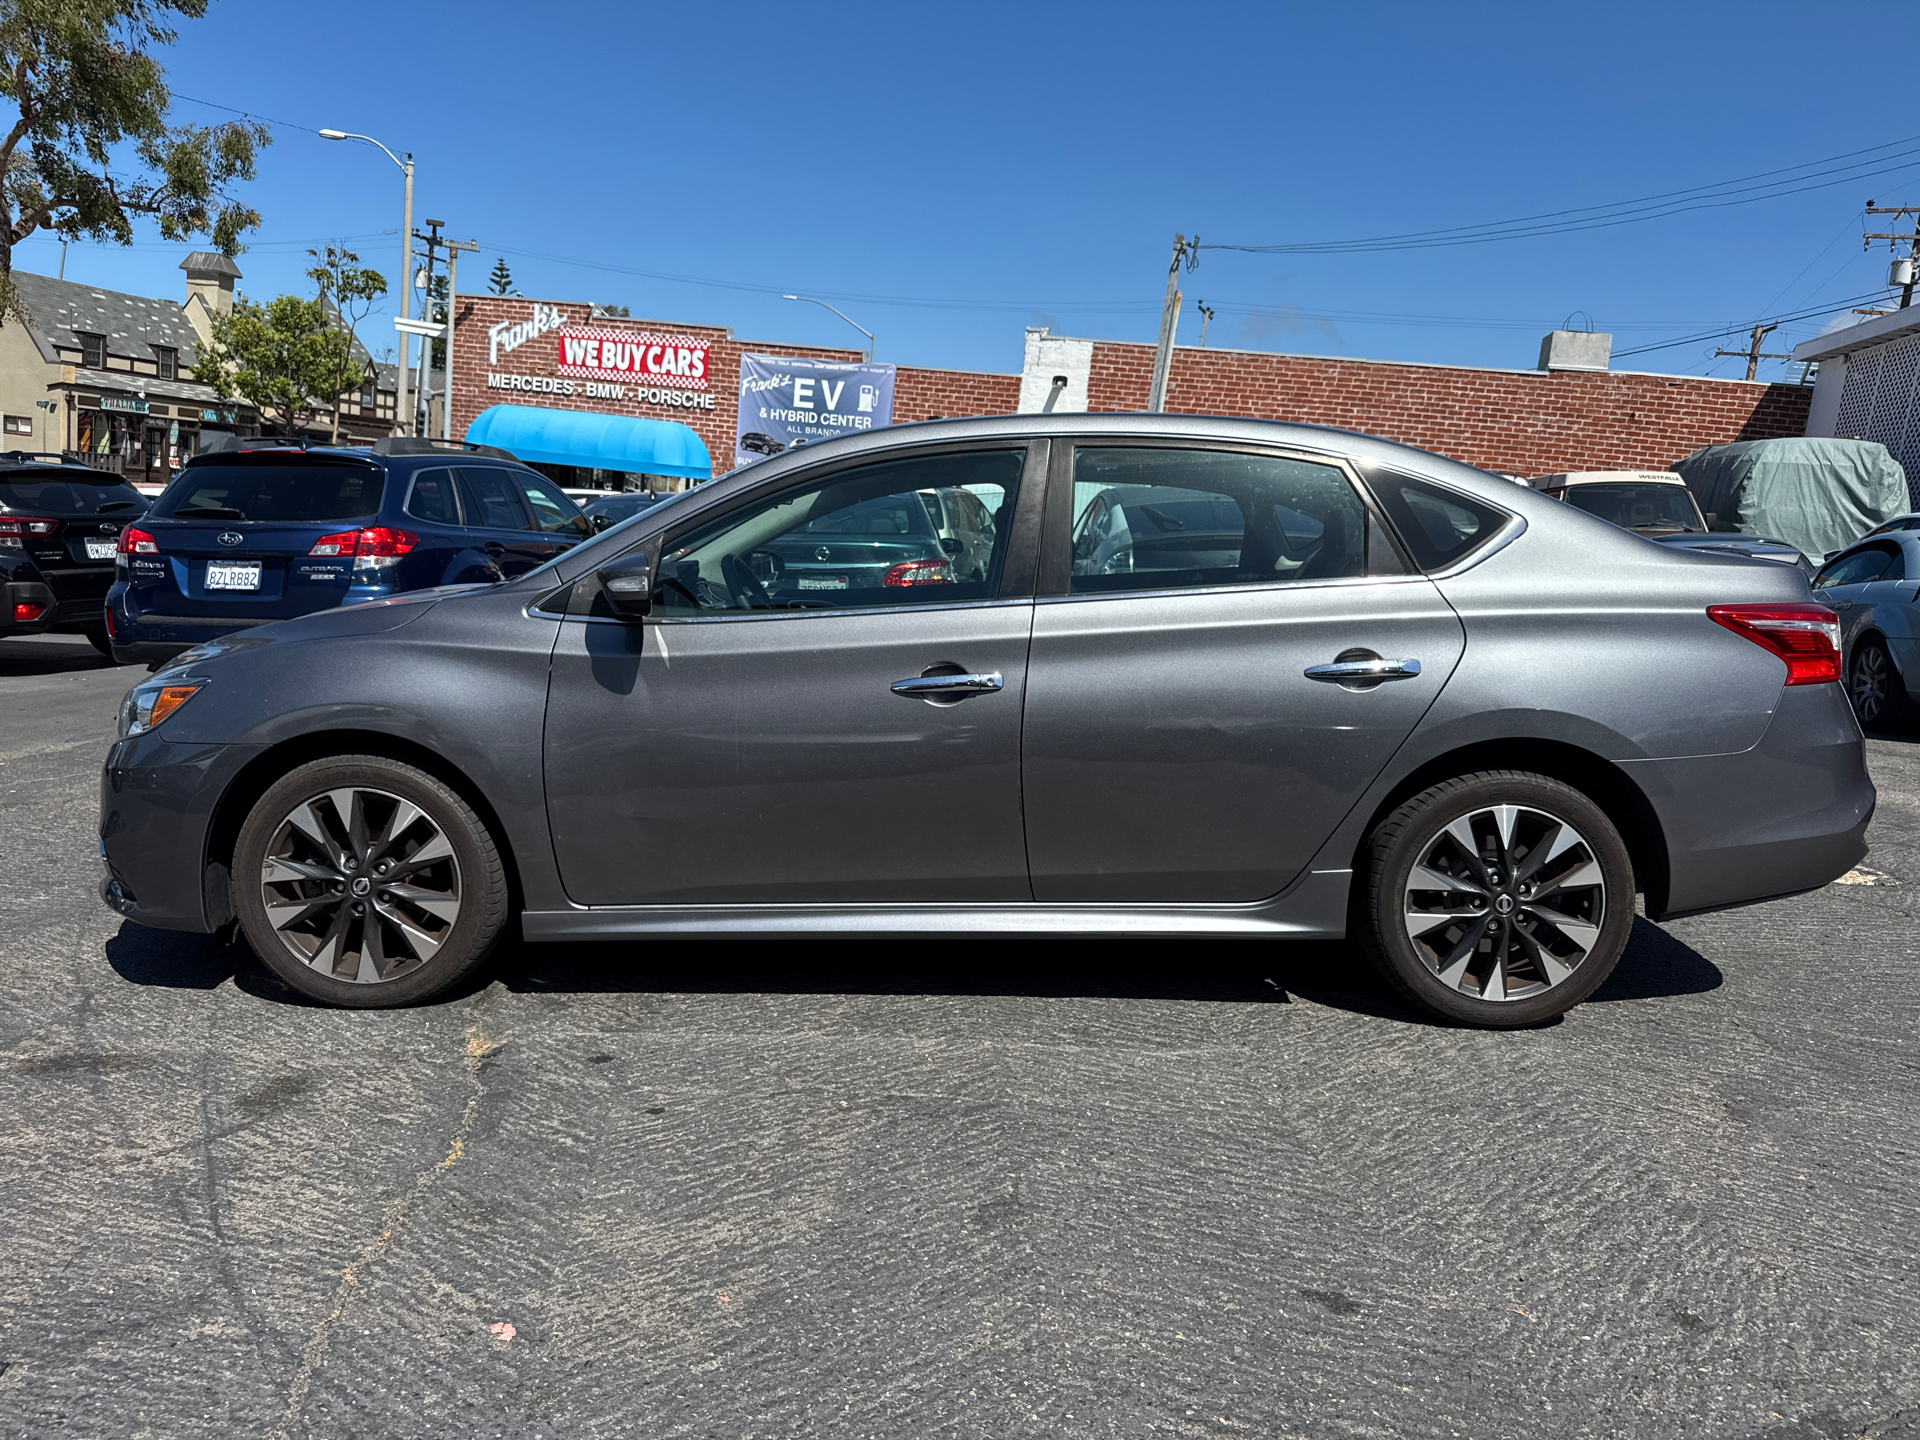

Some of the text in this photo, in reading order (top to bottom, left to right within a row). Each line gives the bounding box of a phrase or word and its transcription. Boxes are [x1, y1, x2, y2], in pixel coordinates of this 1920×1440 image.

[488, 303, 568, 365] Frank's
[564, 338, 705, 377] WE BUY CARS
[488, 372, 715, 409] MERCEDES BMW PORSCHE
[742, 374, 845, 411] Frank's EV
[759, 407, 872, 429] & HYBRID CENTER
[787, 425, 802, 433] ALL
[209, 571, 257, 586] 8ZLR882
